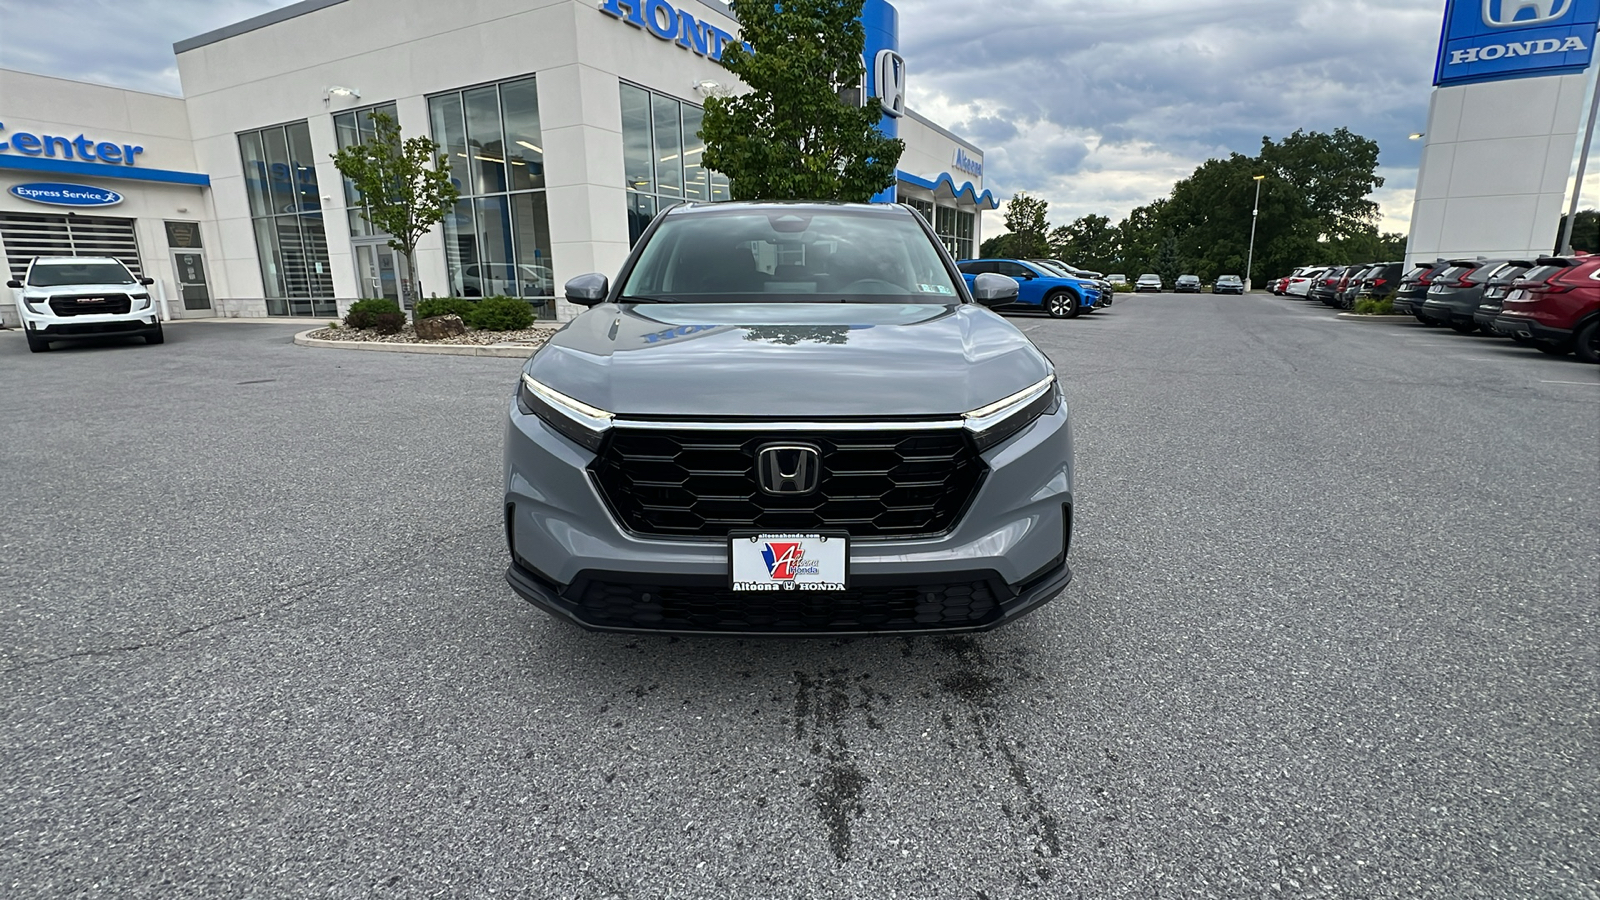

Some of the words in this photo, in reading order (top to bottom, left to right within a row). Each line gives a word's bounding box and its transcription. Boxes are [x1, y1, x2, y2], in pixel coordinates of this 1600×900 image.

[1449, 36, 1587, 65] HONDA
[17, 187, 60, 198] Express
[62, 190, 102, 200] Service
[790, 566, 819, 575] Honda
[732, 582, 780, 591] Altoona
[799, 583, 846, 591] HONDA
